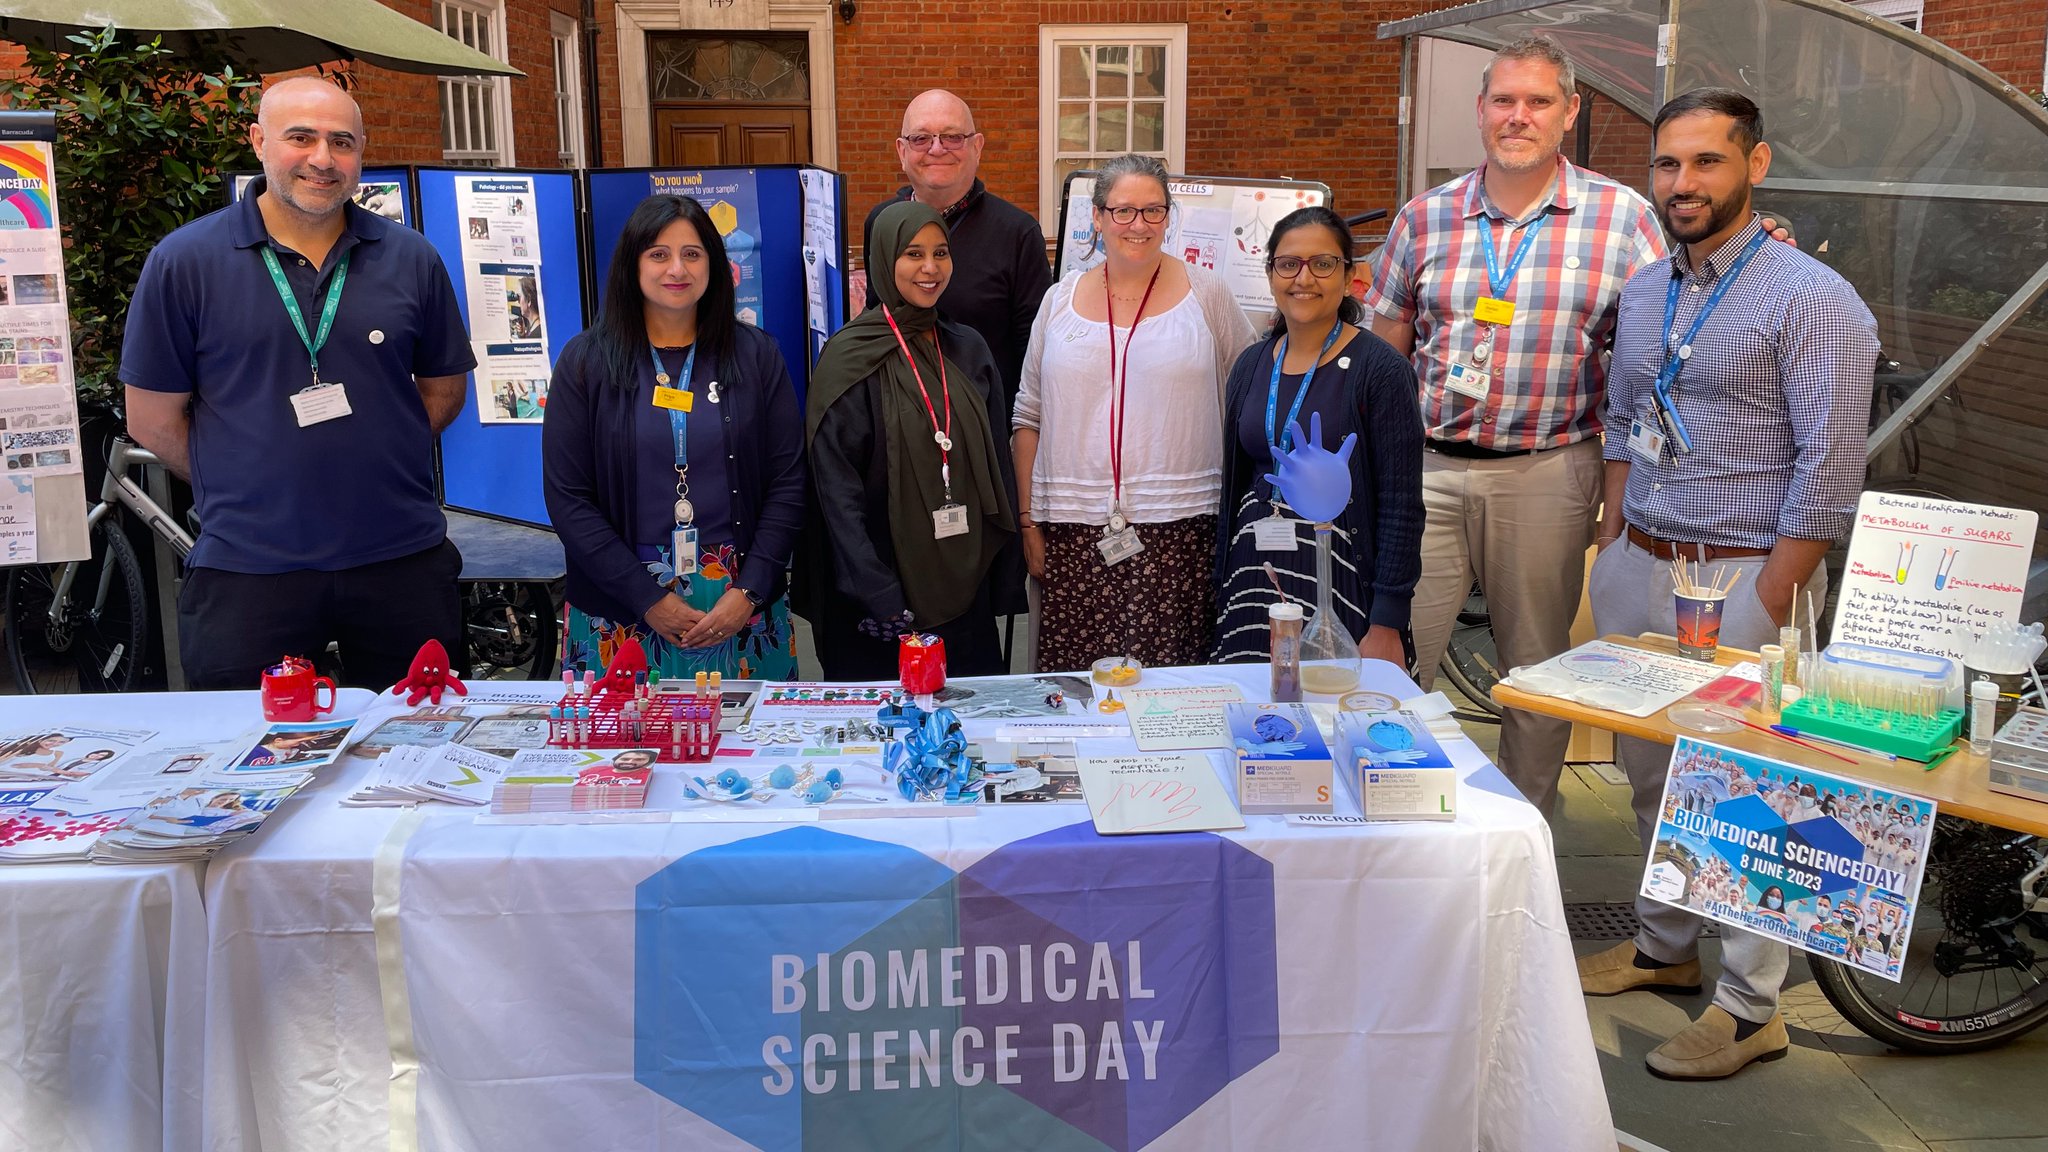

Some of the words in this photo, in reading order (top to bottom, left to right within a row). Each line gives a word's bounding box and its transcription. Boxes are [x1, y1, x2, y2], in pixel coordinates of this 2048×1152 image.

[22, 178, 42, 188] DAY
[655, 177, 665, 186] DO
[667, 176, 681, 186] YOU
[682, 175, 702, 186] KNOW
[671, 187, 694, 196] happens
[696, 186, 702, 194] to
[702, 187, 714, 195] your
[716, 184, 738, 194] sample?
[1180, 184, 1206, 194] CELLS
[1879, 496, 1918, 509] Bacterial
[1922, 502, 1976, 515] Identification
[1980, 509, 2018, 520] Methods:
[1861, 514, 1930, 531] METABOLISM
[1941, 526, 1954, 534] OF
[1964, 528, 2013, 541] SUGARS
[1850, 569, 1892, 580] metabolism
[1852, 561, 1864, 569] No
[1950, 577, 1980, 589] Positive
[1980, 582, 2024, 594] metabolism
[1852, 588, 1868, 599] The
[1871, 592, 1898, 607] ability
[1902, 594, 1910, 604] to
[1914, 599, 1963, 612] metabolise
[1967, 604, 1990, 616] (use
[1844, 612, 1874, 623] create
[1888, 619, 1915, 630] profile
[1846, 600, 1868, 611] fuel,
[1883, 604, 1908, 616] break
[1911, 610, 1943, 624] down)
[1976, 620, 1986, 628] us
[1842, 622, 1882, 634] different
[1887, 630, 1924, 643] sugars.
[1843, 632, 1866, 644] Every
[1869, 637, 1910, 651] bacterial
[1913, 646, 1944, 657] species
[1948, 648, 1964, 659] has
[1136, 688, 1232, 698] FERMENTATION
[444, 755, 502, 775] LIFESAVERS
[1317, 785, 1329, 802] S
[1440, 795, 1452, 813] L
[1674, 808, 1780, 858] BIOMEDICAL
[1784, 840, 1861, 881] SCIENCE
[1862, 864, 1902, 892] DAY
[1740, 854, 1748, 868] 8
[1752, 858, 1784, 880] JUNE
[1788, 868, 1822, 891] 2023
[1704, 900, 1840, 951] #AtTheHeartOfHealthcare
[771, 940, 1156, 1014] BIOMEDICAL
[1910, 1018, 1926, 1028] SWISS
[1938, 1016, 1990, 1032] XM551
[762, 1024, 1022, 1096] SCIENCE
[1052, 1020, 1165, 1083] DAY
